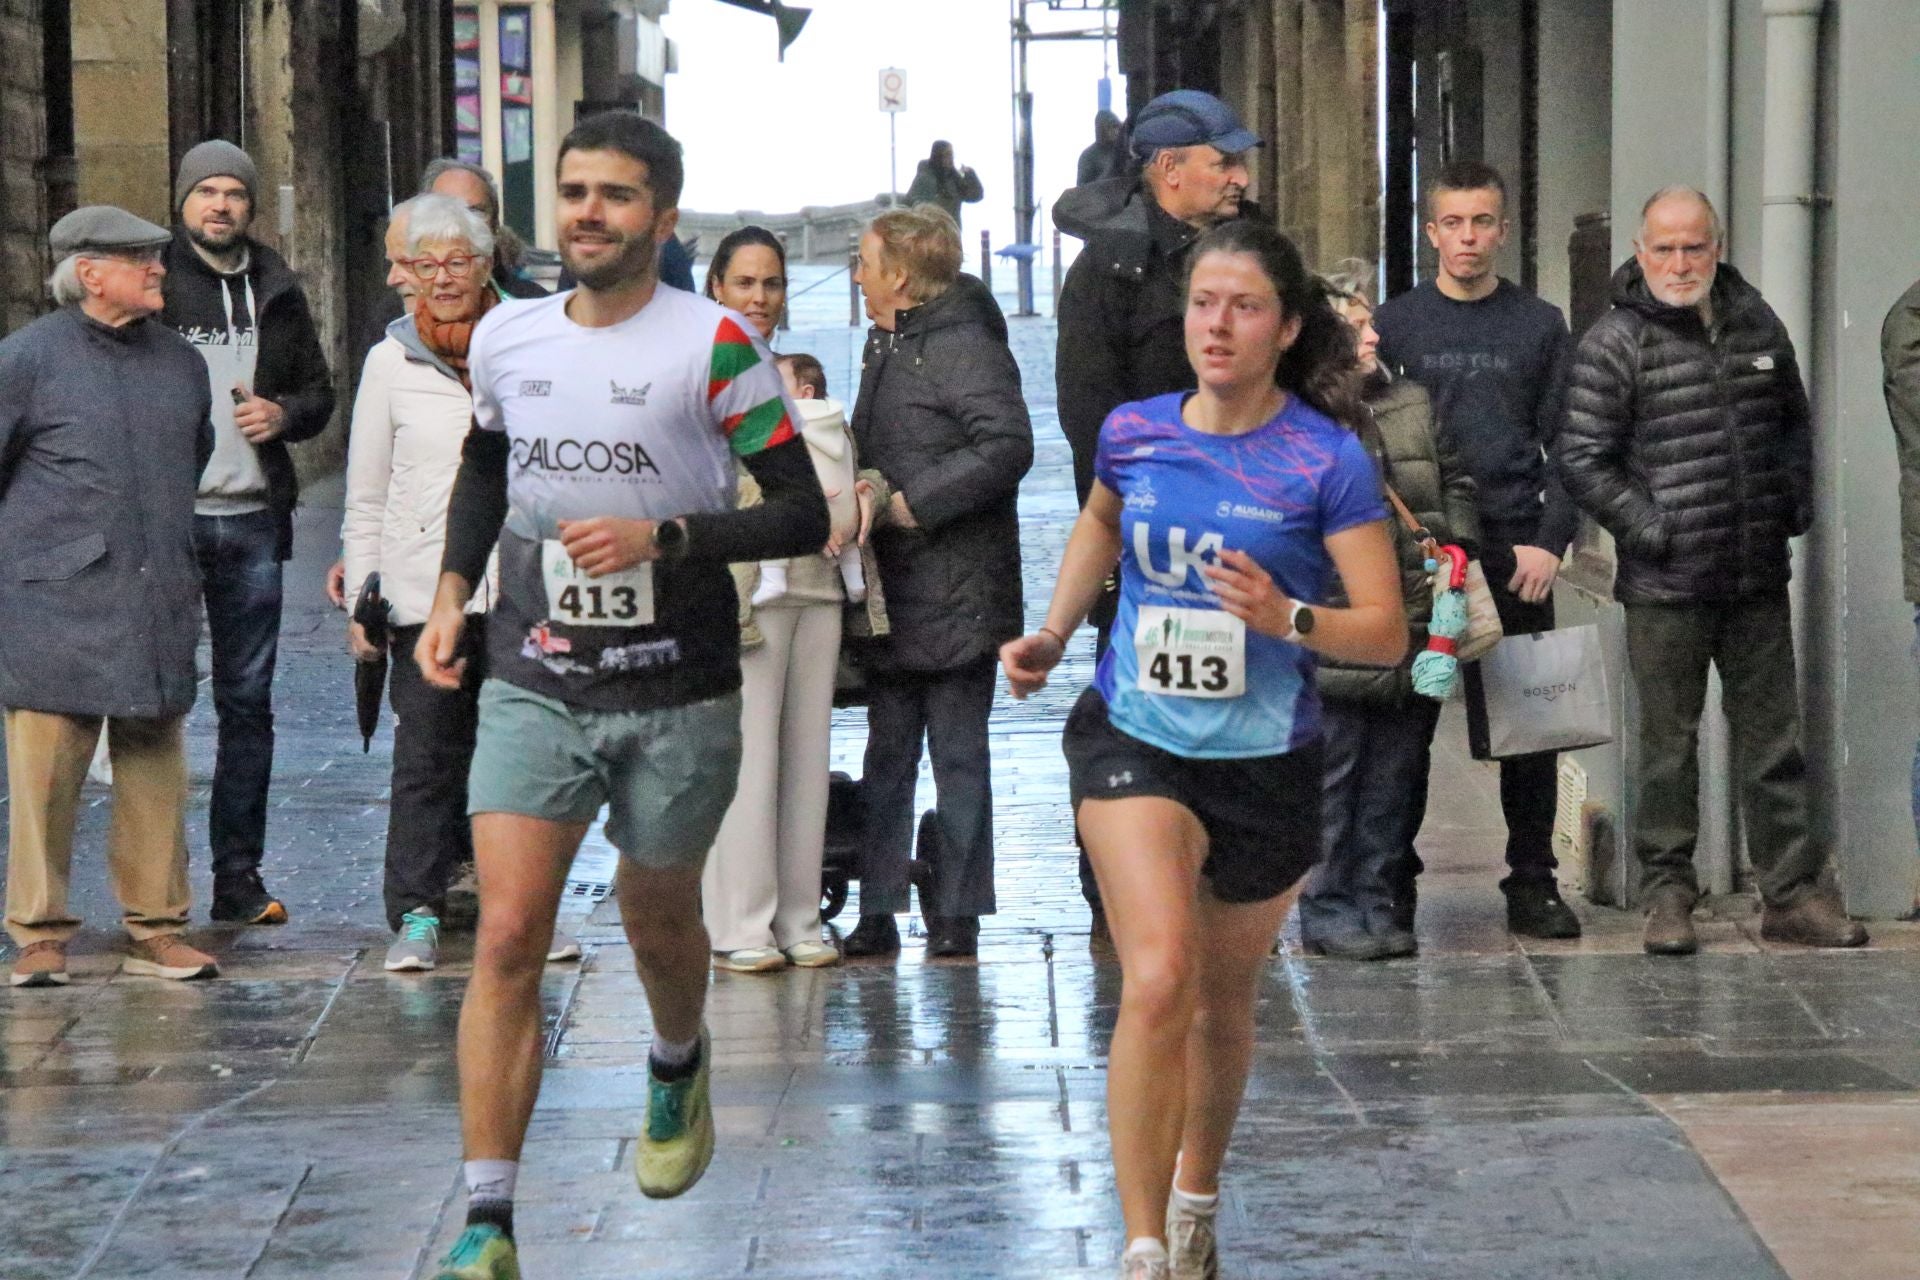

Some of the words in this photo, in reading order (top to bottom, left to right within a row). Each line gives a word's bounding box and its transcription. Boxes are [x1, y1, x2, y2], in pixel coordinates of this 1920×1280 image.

[513, 437, 661, 475] CALCOSA
[558, 585, 638, 620] 413
[1149, 652, 1229, 691] 413
[1523, 682, 1576, 698] BOSTON
